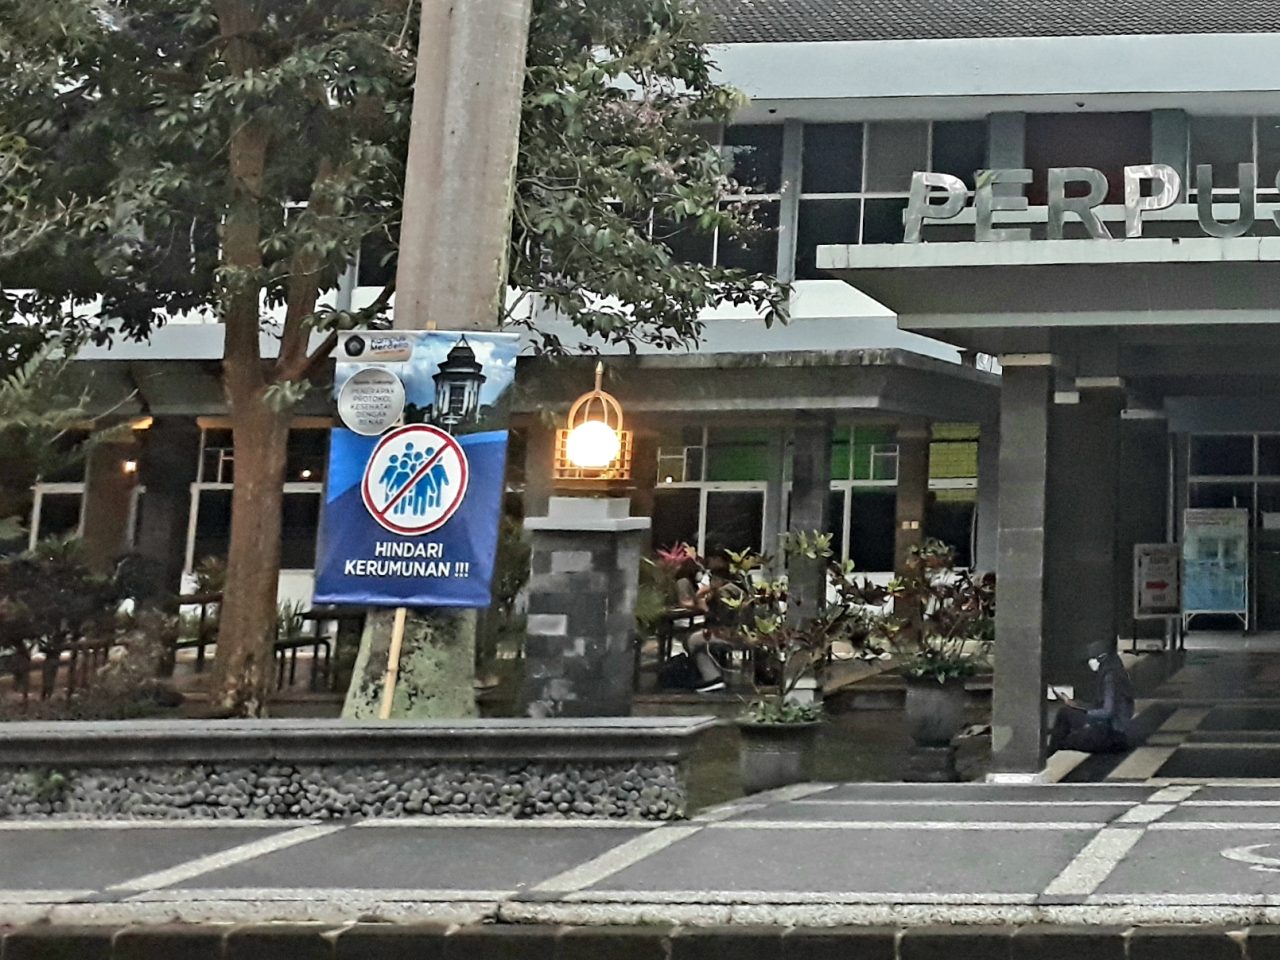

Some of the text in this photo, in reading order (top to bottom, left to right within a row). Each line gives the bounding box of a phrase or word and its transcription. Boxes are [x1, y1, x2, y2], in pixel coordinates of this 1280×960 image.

[374, 541, 443, 558] HINDARI
[344, 559, 469, 577] KERUMUNAN !!!
